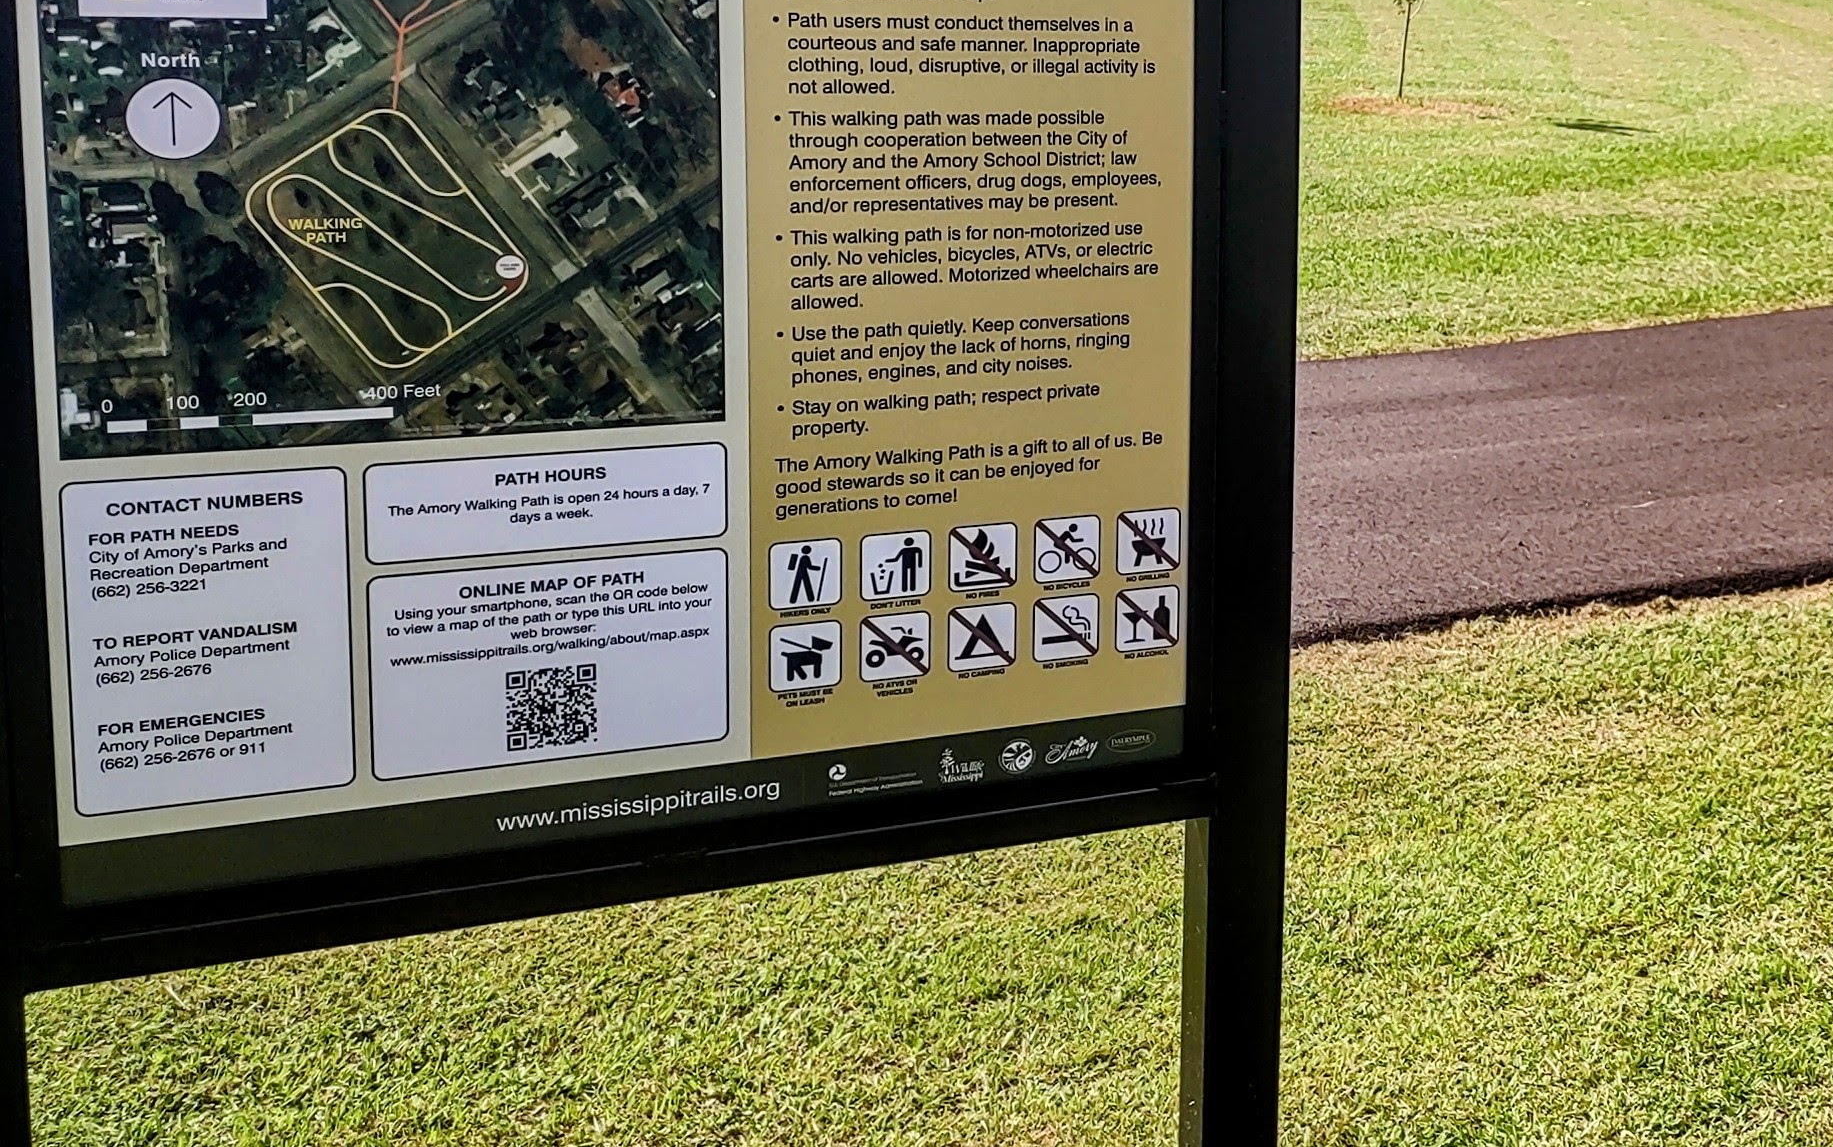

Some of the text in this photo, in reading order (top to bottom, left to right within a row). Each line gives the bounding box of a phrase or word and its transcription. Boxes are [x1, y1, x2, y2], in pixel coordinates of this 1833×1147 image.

[141, 52, 200, 68] North
[288, 218, 363, 230] WALKING
[306, 231, 347, 243] PATH
[166, 395, 200, 410] 100
[233, 392, 267, 407] 200
[366, 383, 441, 400] 400 Feet
[101, 399, 113, 414] 0
[496, 467, 606, 486] PATH HOURS
[106, 491, 303, 516] CONTACT NUMBERS
[89, 524, 239, 546] FOR PATH NEEDS
[90, 538, 287, 565] City of Amory's Parks and
[90, 557, 268, 581] Recreation Department
[92, 579, 205, 601] (662) 256-3221
[459, 571, 644, 598] ONLINE MAP OF PATH
[92, 622, 297, 650] TO REPORT VANDALISM
[390, 628, 709, 666] www.mississippitrails.org/walking/about/map.aspx
[98, 708, 265, 736] FOR EMERGENCIES
[497, 783, 779, 830] www.mississippitrails.org
